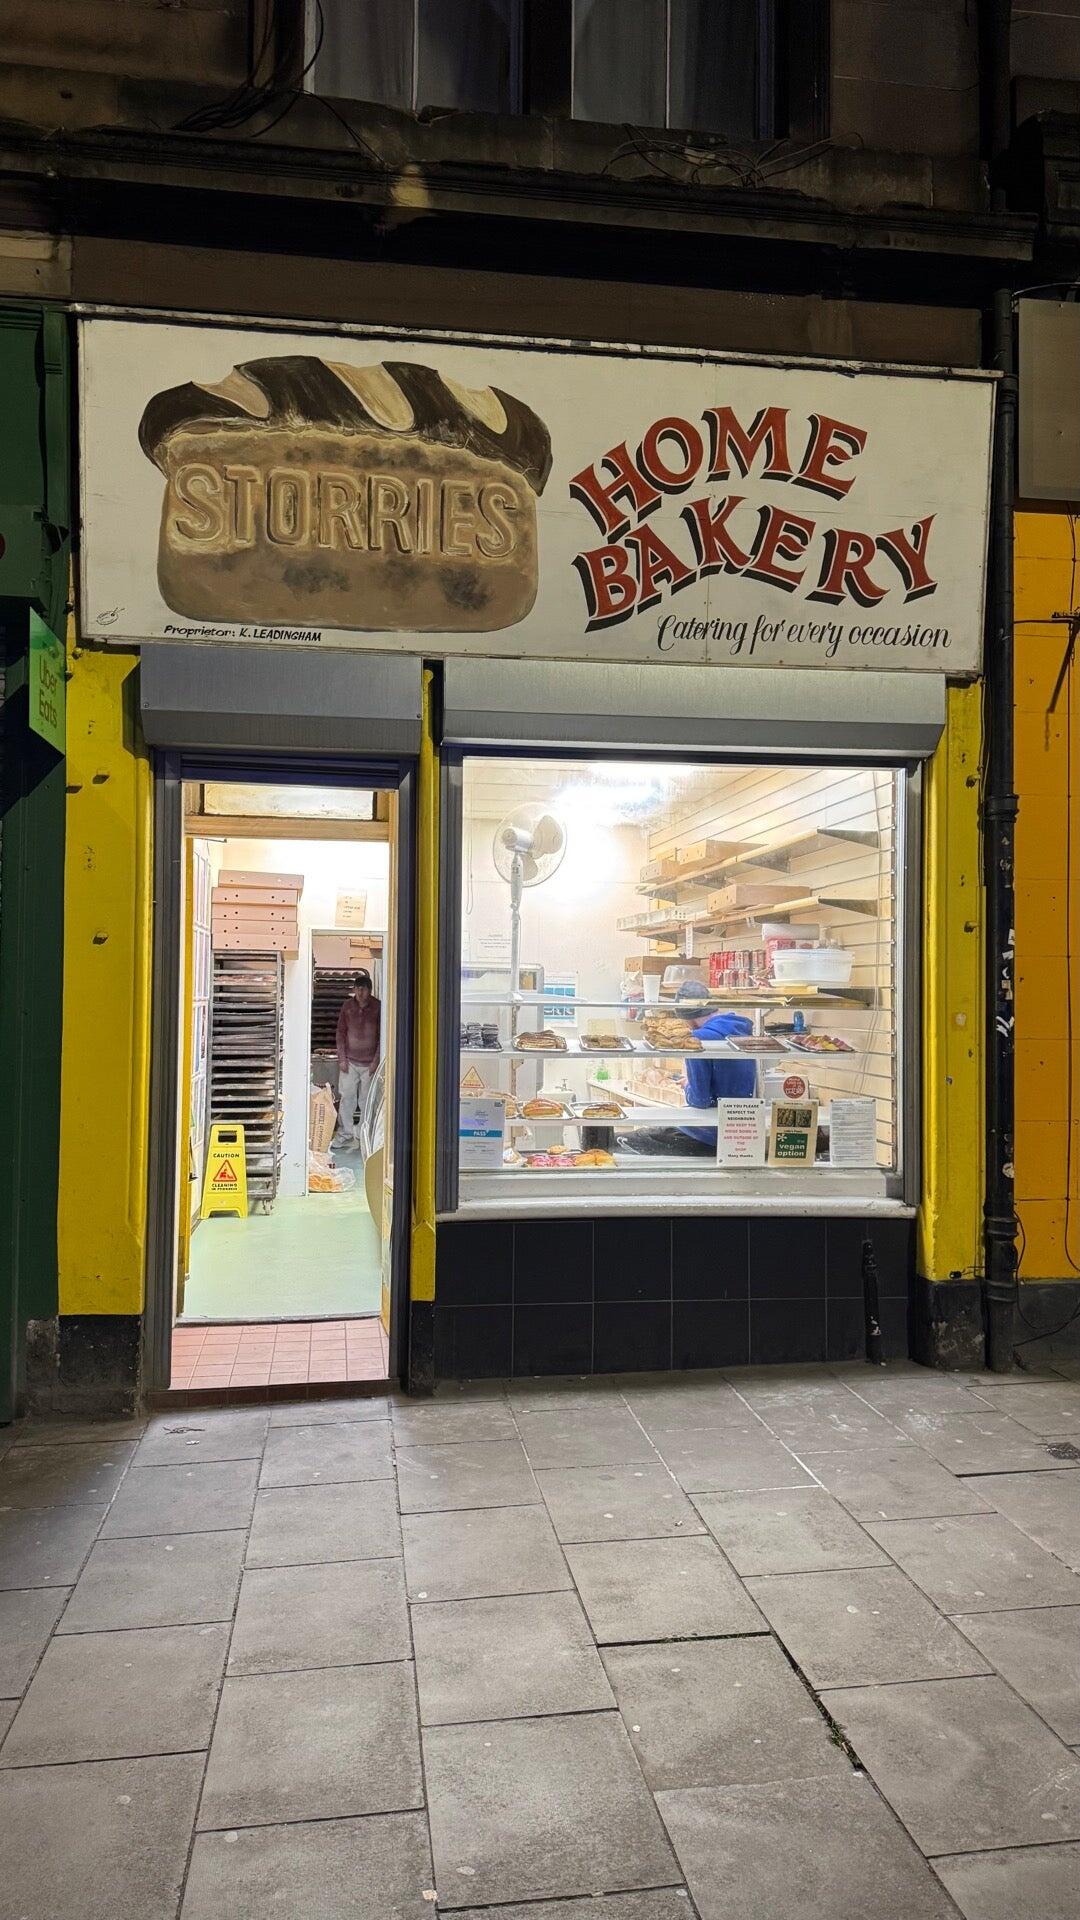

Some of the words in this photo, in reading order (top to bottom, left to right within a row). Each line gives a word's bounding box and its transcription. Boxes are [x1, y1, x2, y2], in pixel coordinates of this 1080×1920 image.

[569, 406, 867, 544] HOME
[172, 462, 520, 559] STORRIES
[571, 495, 938, 633] BAKERY
[164, 625, 235, 638] Proprietor:
[239, 627, 251, 638] K.
[253, 628, 322, 641] LEADINGHAM
[657, 614, 748, 655] Catering
[750, 614, 784, 655] for
[787, 620, 844, 658] every
[849, 624, 952, 648] occasion
[39, 655, 58, 697] Uber
[38, 691, 58, 729] Eats
